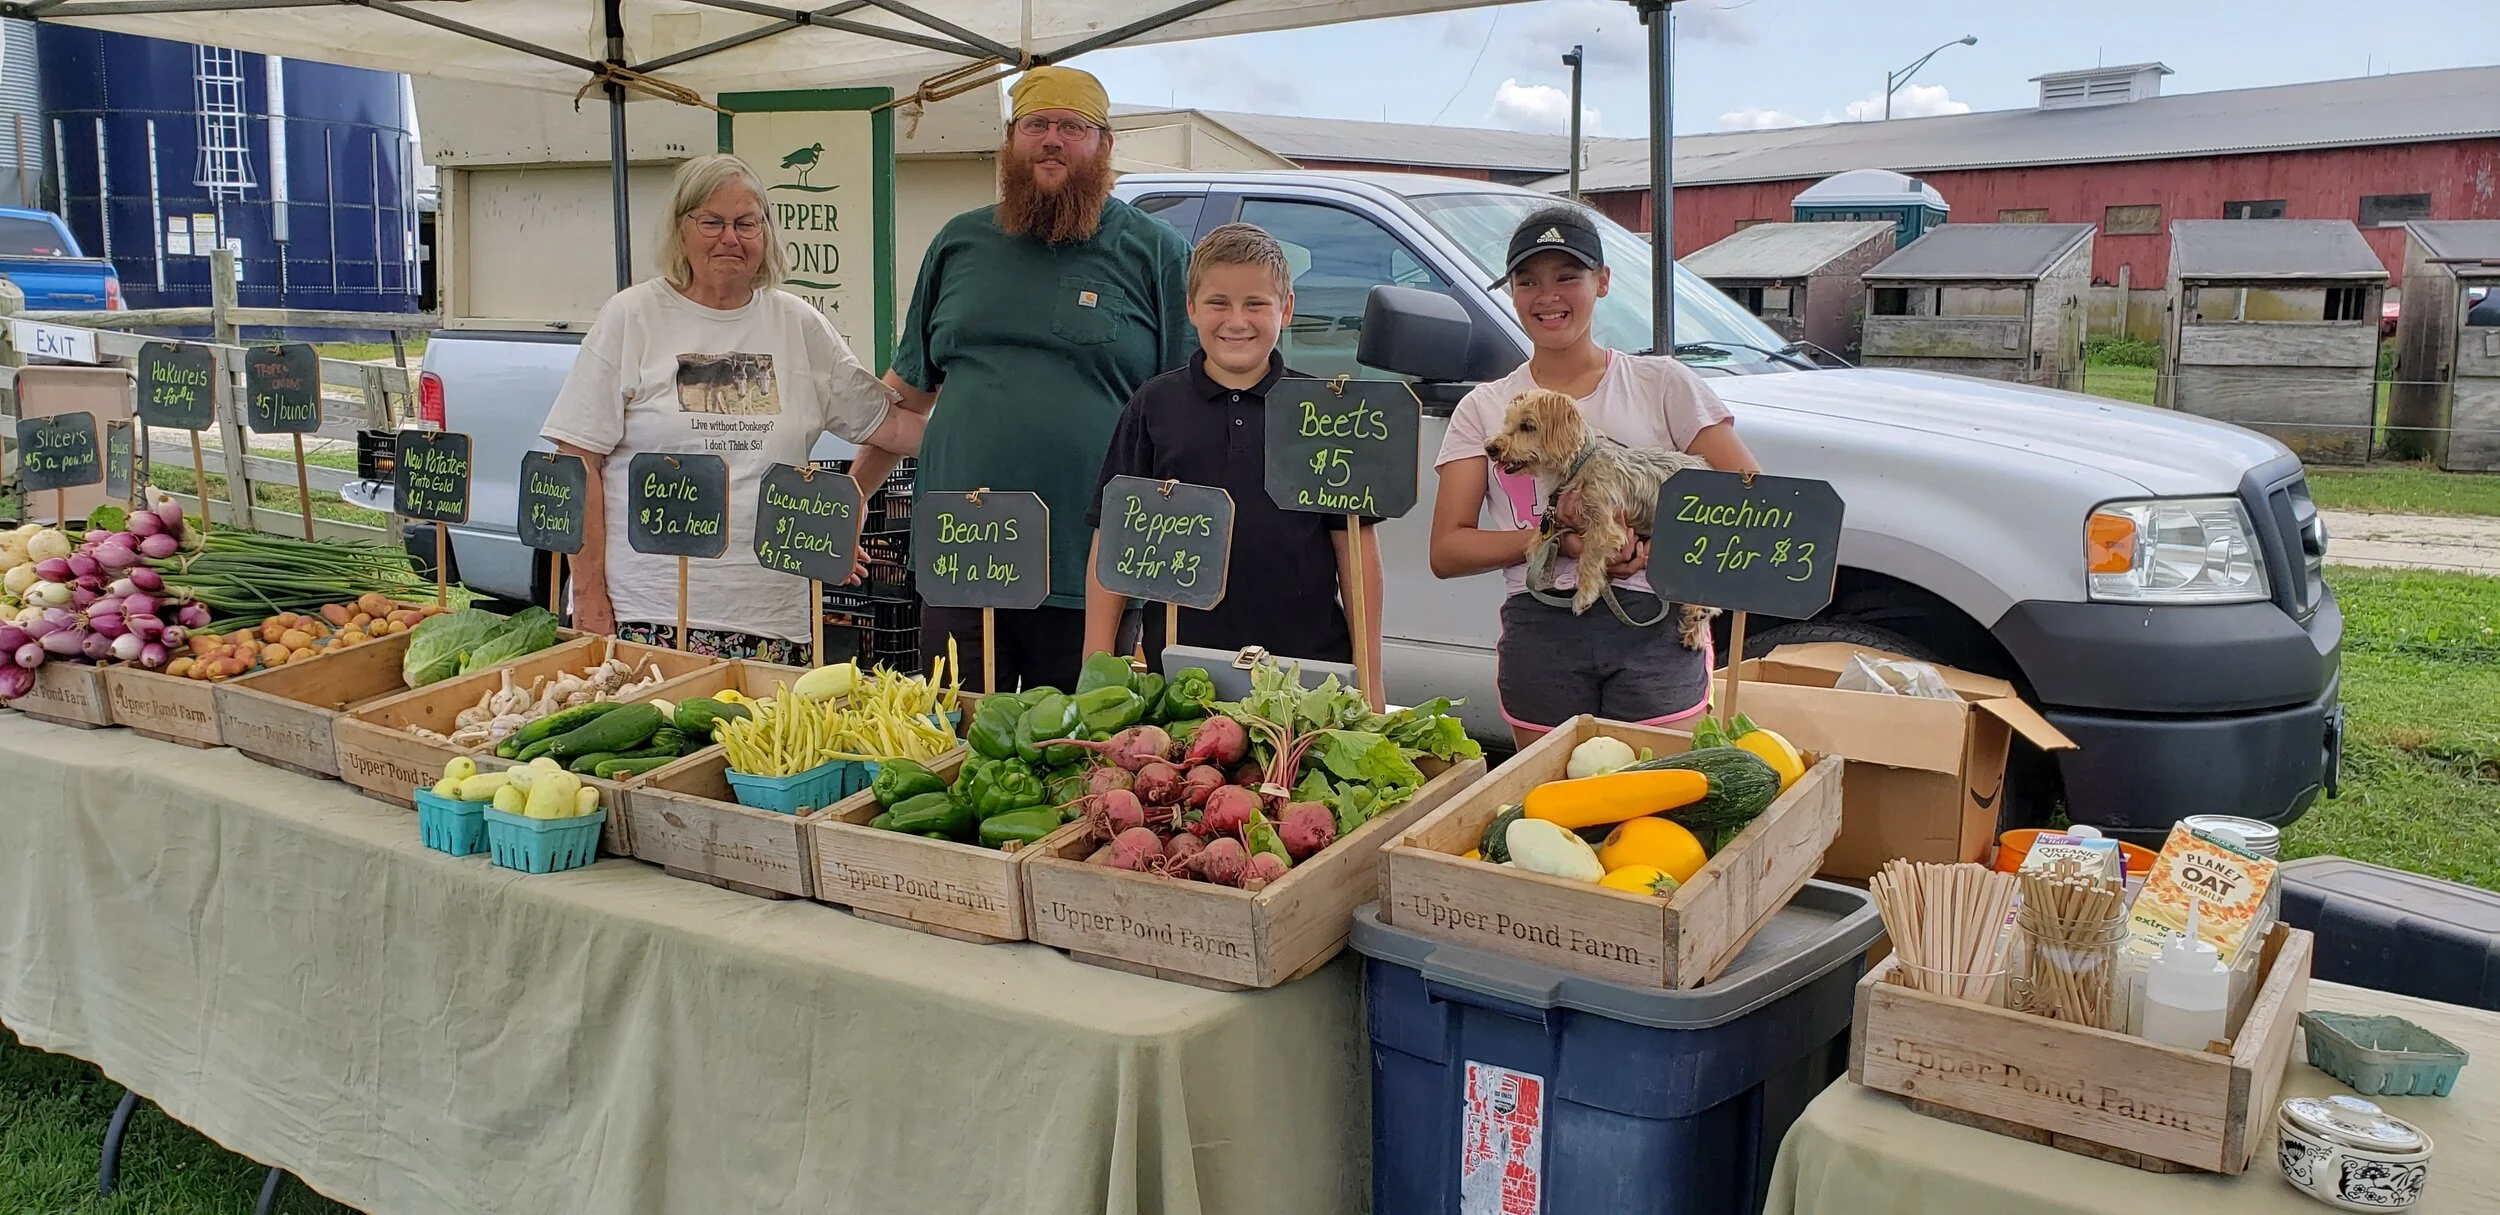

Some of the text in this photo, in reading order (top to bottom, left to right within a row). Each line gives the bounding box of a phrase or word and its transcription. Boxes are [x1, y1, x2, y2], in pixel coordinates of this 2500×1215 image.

[1536, 236, 1565, 244] adidas
[786, 242, 840, 274] OND
[36, 329, 75, 357] EXIT
[153, 385, 194, 411] 2 for $4
[691, 418, 708, 430] Live
[709, 420, 738, 431] without
[1299, 398, 1388, 441] Beets
[36, 430, 87, 448] Slicers
[704, 438, 763, 451] I don't Think So!
[24, 451, 43, 472] $5
[46, 456, 59, 469] a
[62, 448, 94, 472] pound
[404, 446, 468, 478] New Potatoes
[1309, 448, 1354, 487] $5
[409, 471, 454, 493] Pinto Gold
[530, 471, 571, 507] Cabbage
[644, 472, 698, 501] Garlic
[407, 488, 463, 517] $4 a pound
[766, 483, 850, 518] Cucumbers
[1298, 485, 1380, 517] a bunch
[1676, 492, 1797, 528] Zucchini
[531, 502, 570, 534] $3 each
[640, 507, 720, 536] $3 a head
[937, 513, 1018, 544] Beans
[1124, 495, 1212, 544] Peppers
[776, 516, 842, 558] $1 each
[933, 552, 1020, 587] $4 a box
[1117, 545, 1201, 587] 2 for $3
[1684, 535, 1815, 582] 2 for $3
[41, 686, 64, 701] Pond
[65, 689, 88, 706] Farm
[120, 693, 207, 723] Upper Pond Farm
[349, 752, 385, 777] Upper
[387, 763, 419, 785] Pond
[2038, 847, 2100, 859] ORGANIC
[2187, 853, 2244, 882] PLANET
[834, 862, 996, 911] Upper Pond Farm
[2181, 880, 2225, 904] OATMILK
[2182, 867, 2235, 896] OAT
[1051, 901, 1239, 959] Upper Pond Farm
[1413, 894, 1641, 965] Upper Pond Farm
[2135, 916, 2171, 932] extra
[1893, 1038, 2192, 1132] Upper Pond Farm
